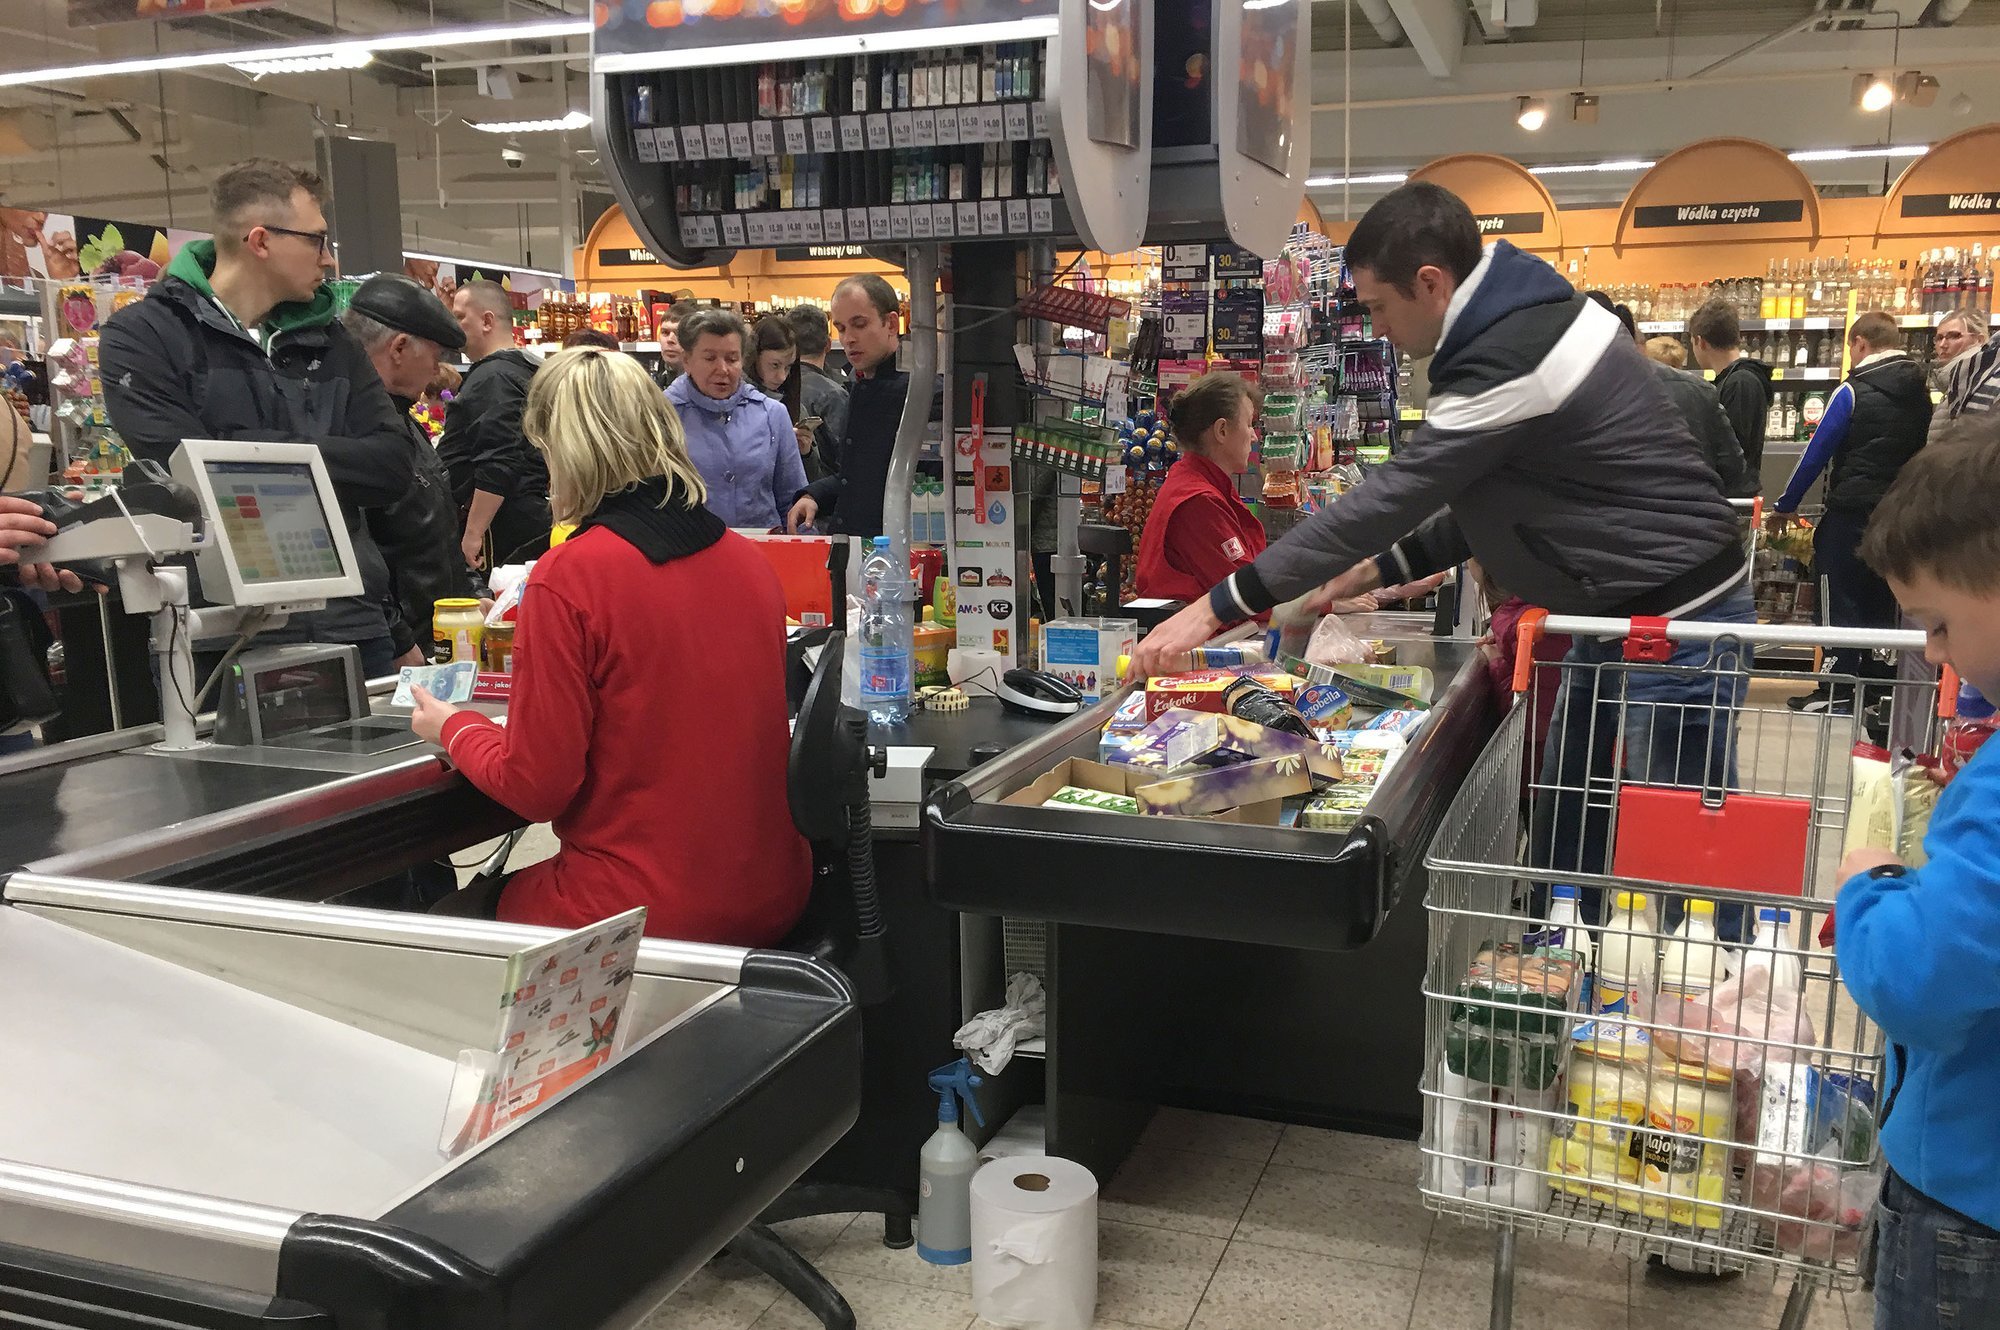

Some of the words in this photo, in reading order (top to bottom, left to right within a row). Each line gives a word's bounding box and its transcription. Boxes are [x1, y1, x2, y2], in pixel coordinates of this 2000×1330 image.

[1949, 193, 1992, 209] Wódka
[1678, 205, 1717, 220] Wódka
[1721, 205, 1760, 222] czysta
[1218, 254, 1231, 267] 30
[1217, 328, 1230, 340] 30
[991, 602, 1009, 613] K2
[401, 668, 413, 684] 50
[1153, 692, 1197, 713] Łakotki
